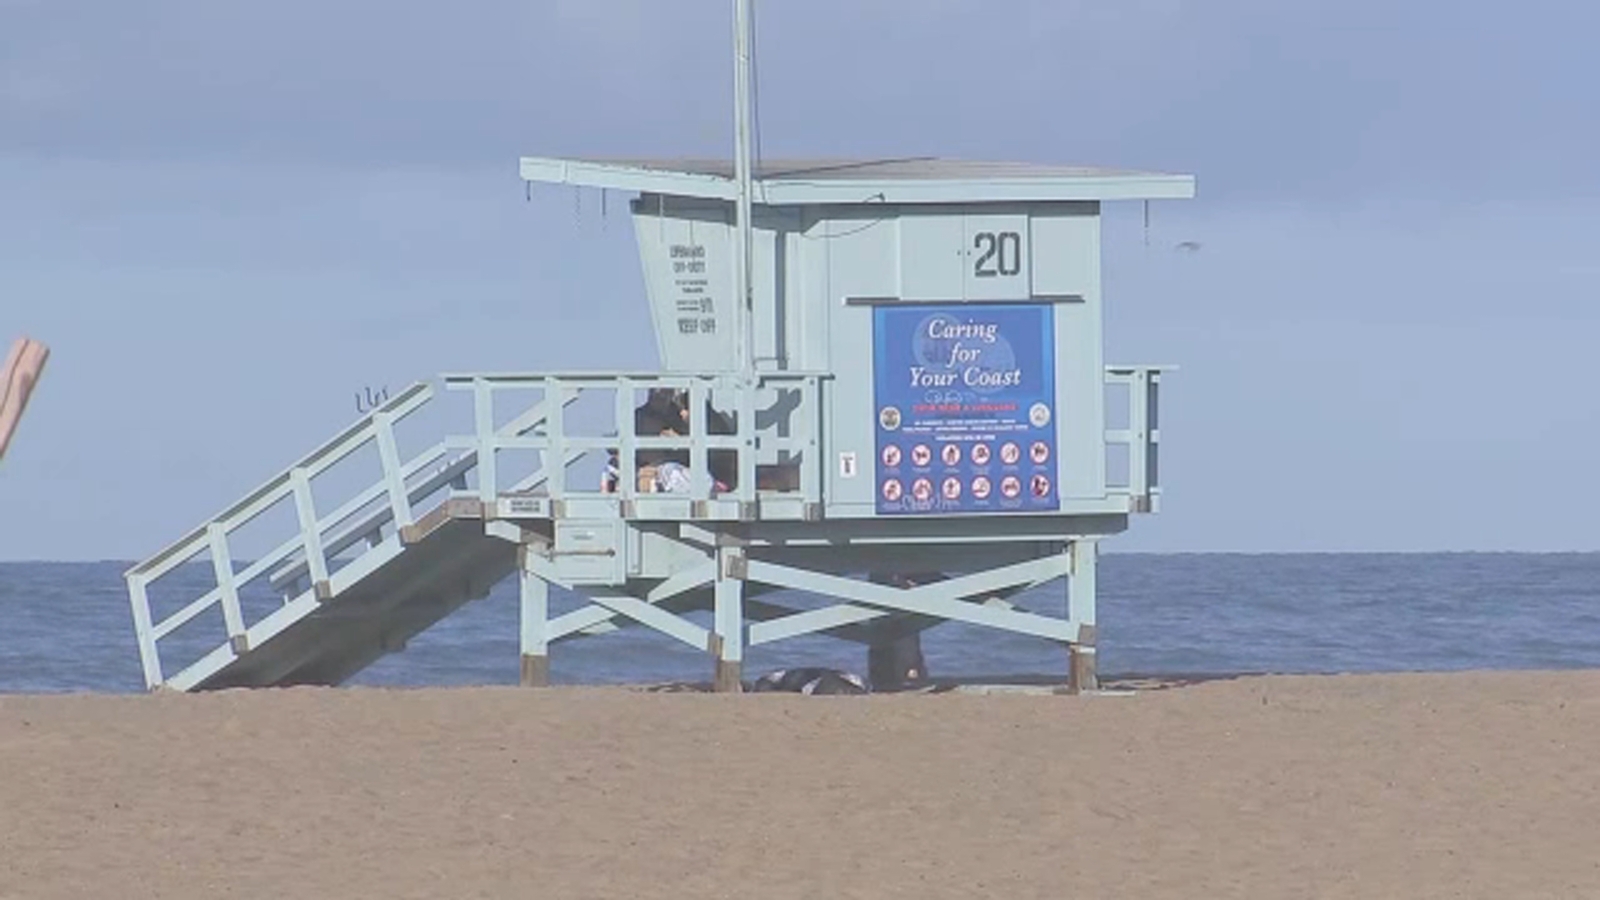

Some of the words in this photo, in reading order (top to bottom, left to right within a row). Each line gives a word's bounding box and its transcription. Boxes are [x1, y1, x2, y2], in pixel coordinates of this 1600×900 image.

[974, 231, 1020, 277] 20
[928, 318, 998, 343] Caring
[946, 342, 981, 368] for
[909, 366, 958, 387] Your
[963, 366, 1021, 387] Coast
